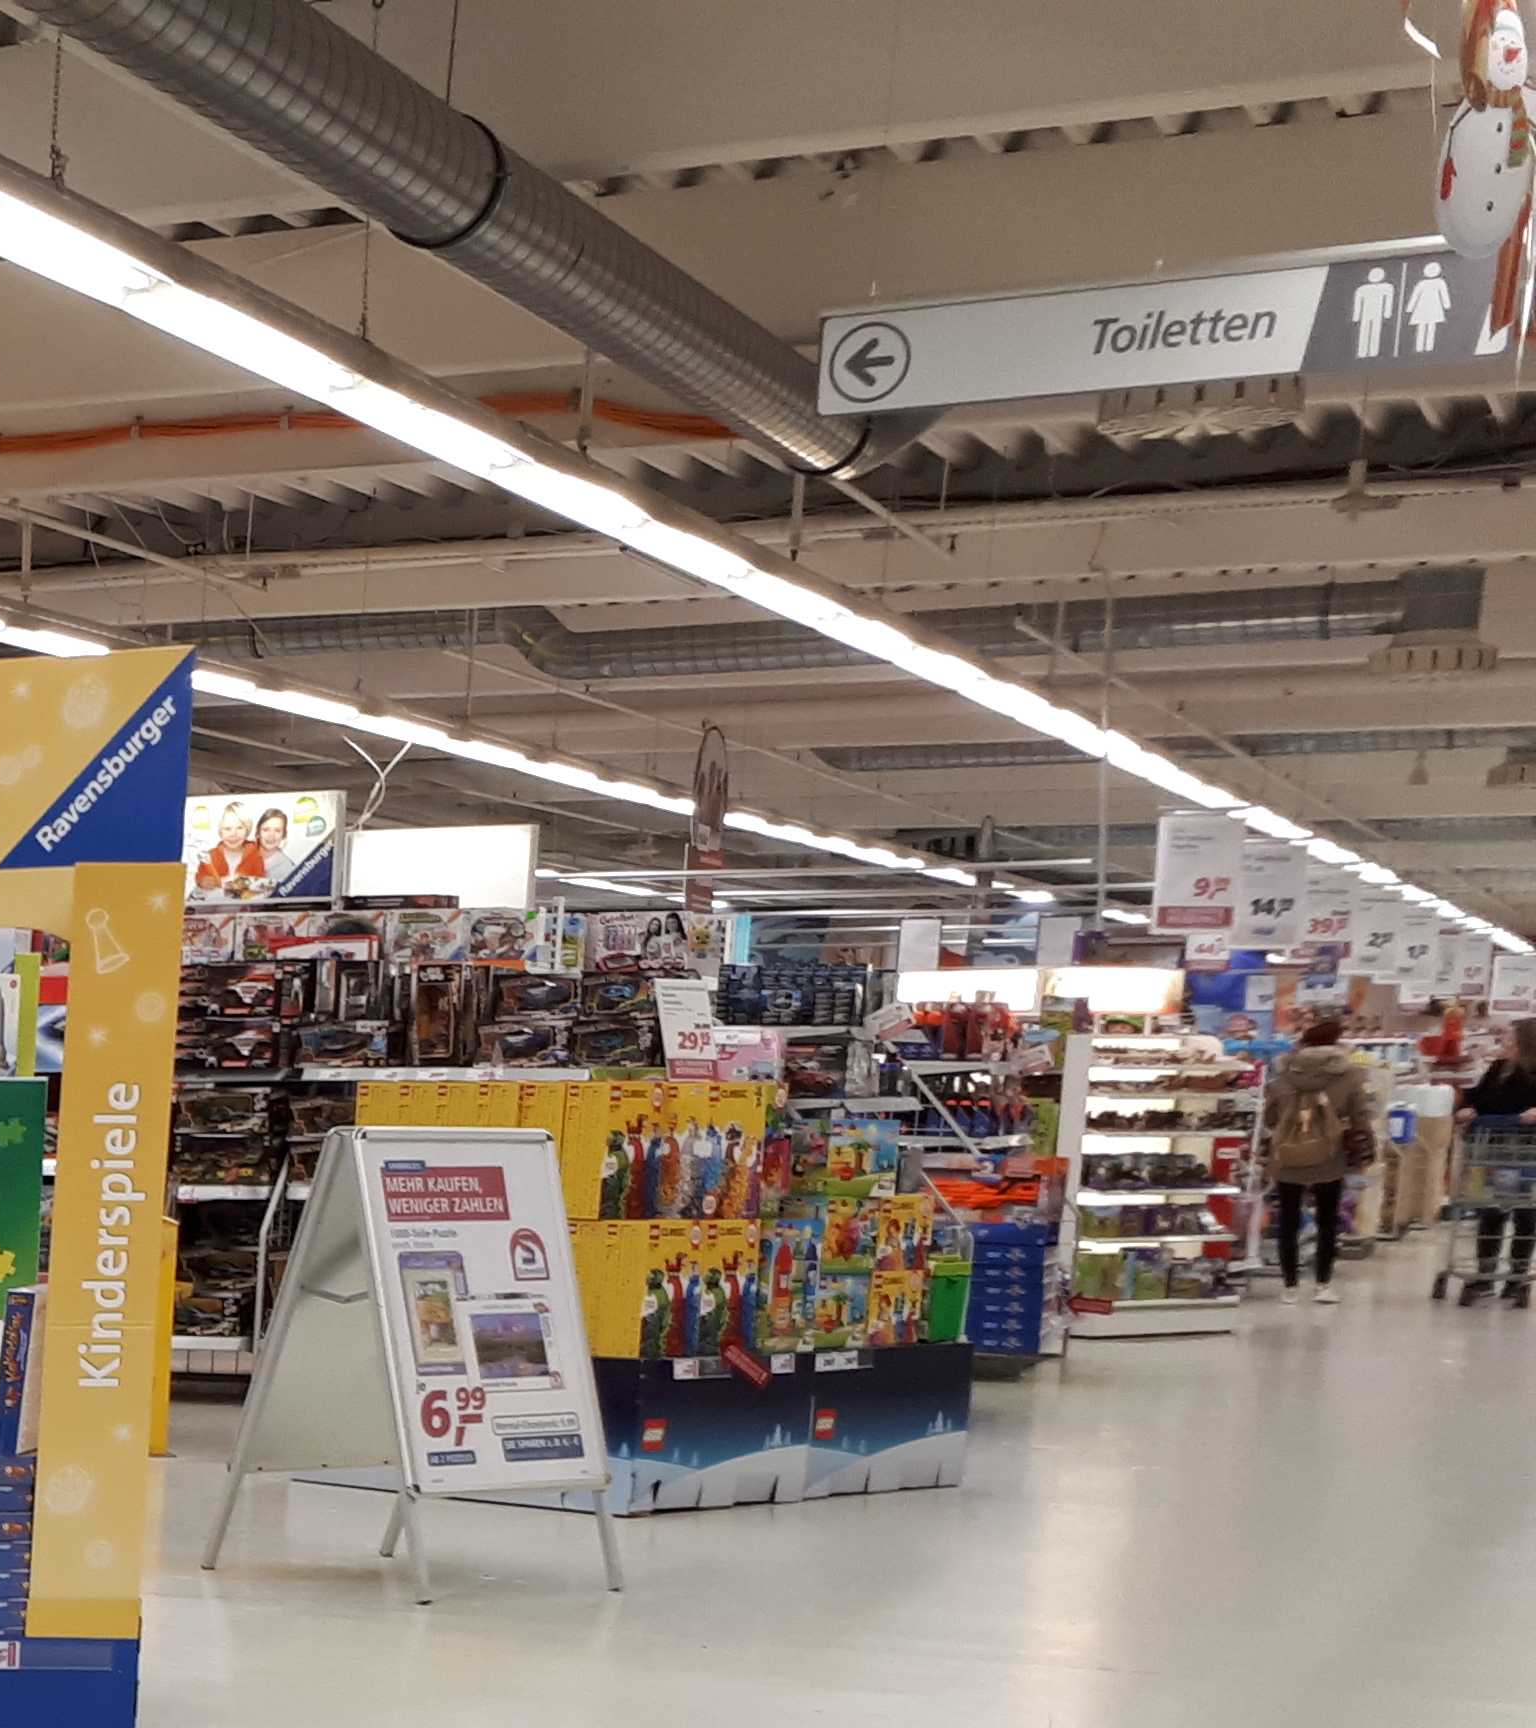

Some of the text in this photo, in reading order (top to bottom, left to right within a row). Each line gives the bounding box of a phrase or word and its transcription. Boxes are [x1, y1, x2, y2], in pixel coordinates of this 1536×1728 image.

[1092, 306, 1277, 355] Toiletten
[34, 694, 179, 854] Ravensburger
[277, 841, 333, 898] Ravensburger
[385, 1176, 483, 1194] MEHR KAUFEN,
[388, 1197, 451, 1215] WENIGER
[78, 1082, 148, 1389] Kinderspiele
